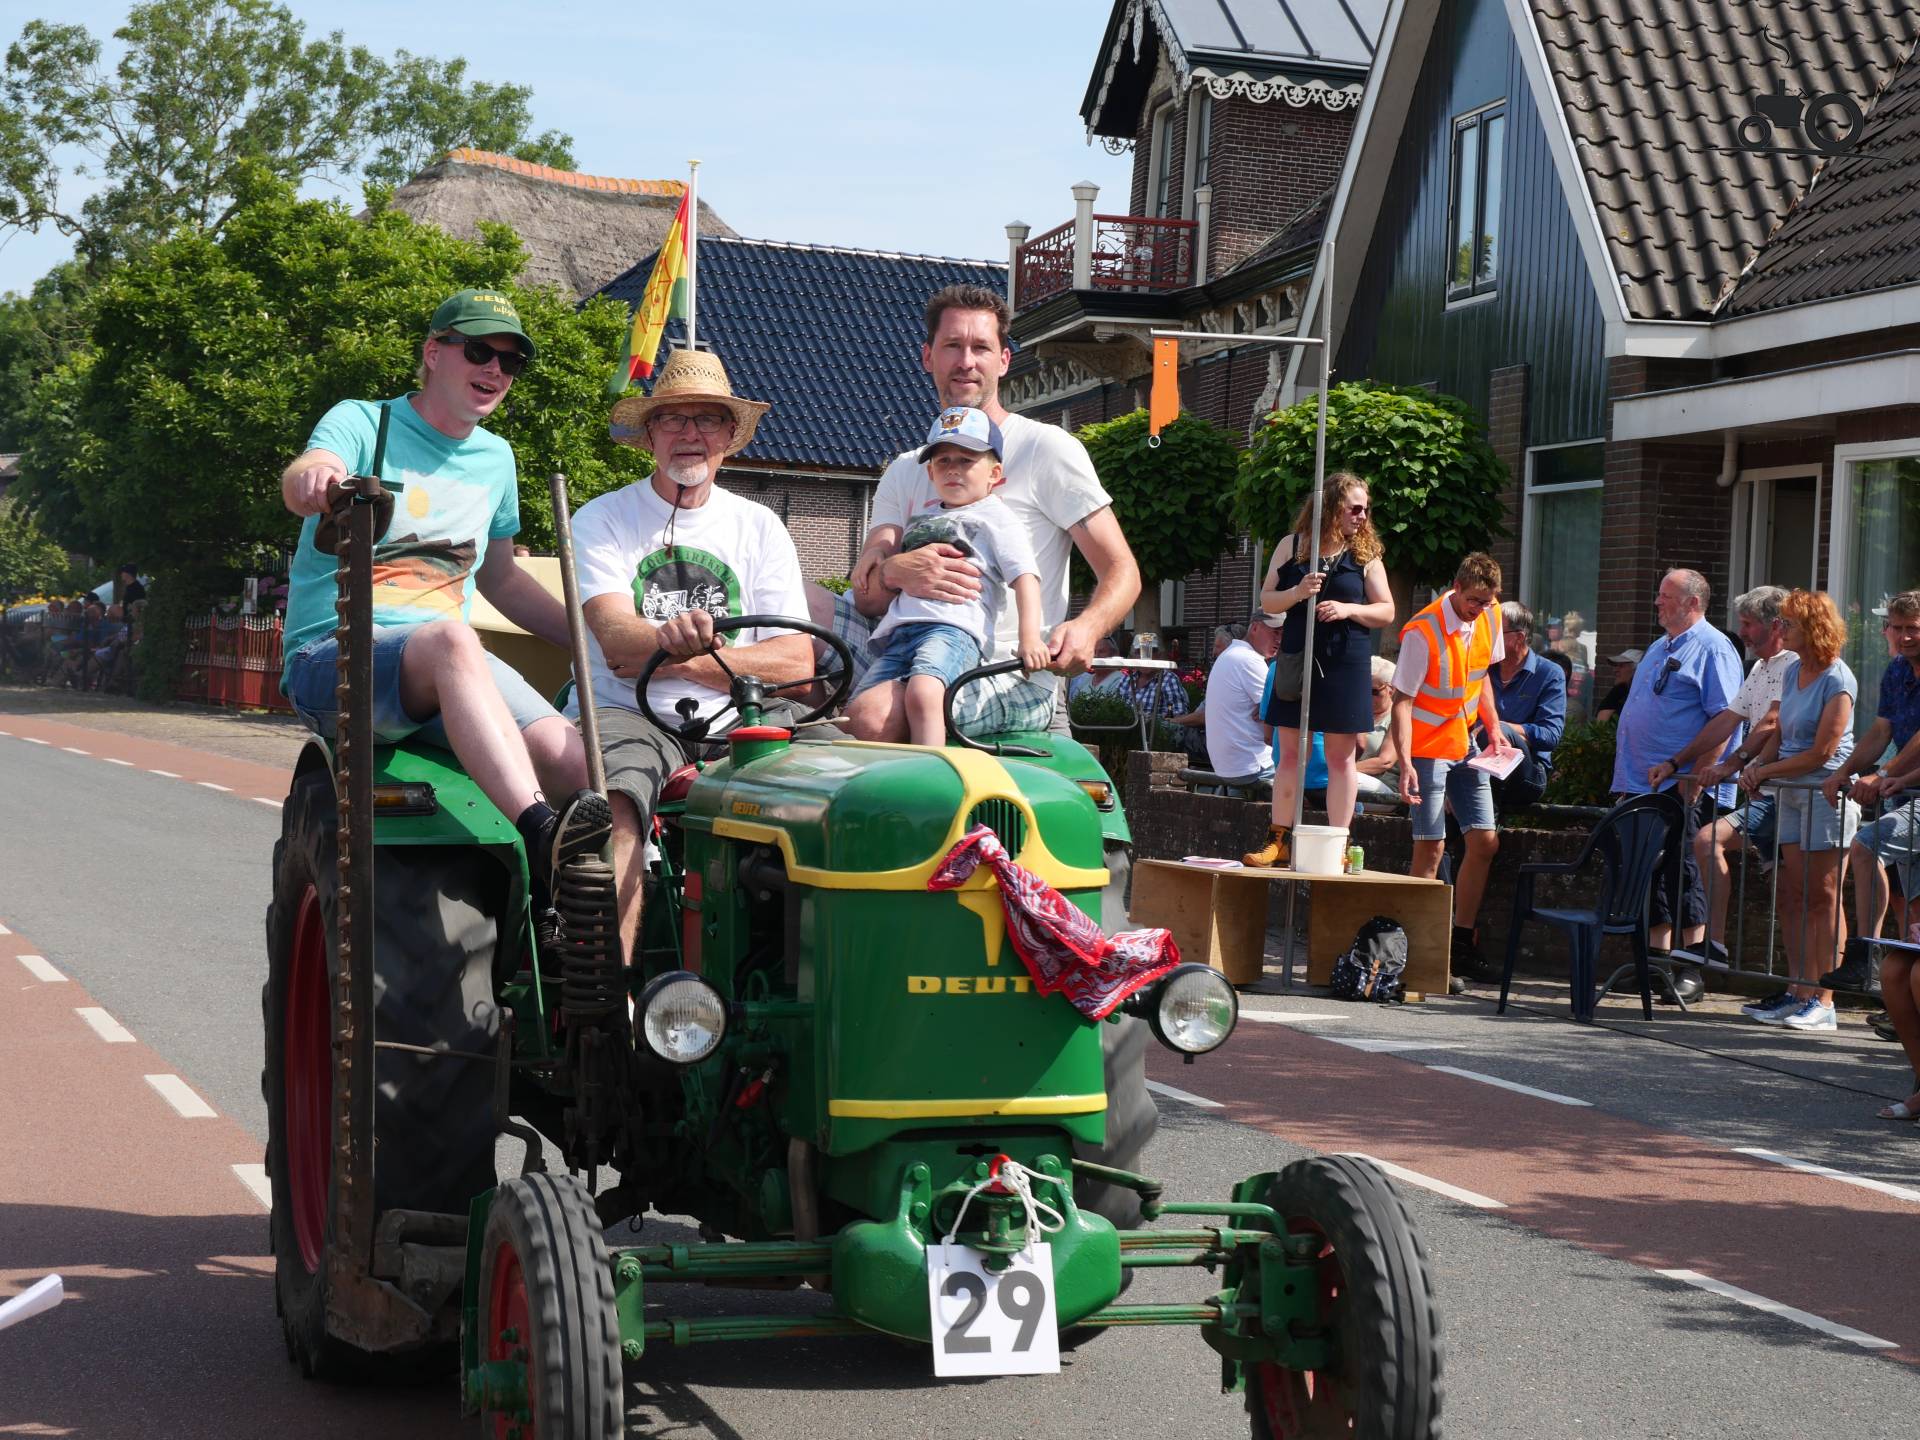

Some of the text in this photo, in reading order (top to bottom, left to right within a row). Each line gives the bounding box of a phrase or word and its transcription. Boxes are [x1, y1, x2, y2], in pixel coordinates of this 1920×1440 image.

[731, 799, 761, 817] DEUTZ
[907, 975, 1046, 994] DEUT
[940, 1270, 1046, 1354] 29
